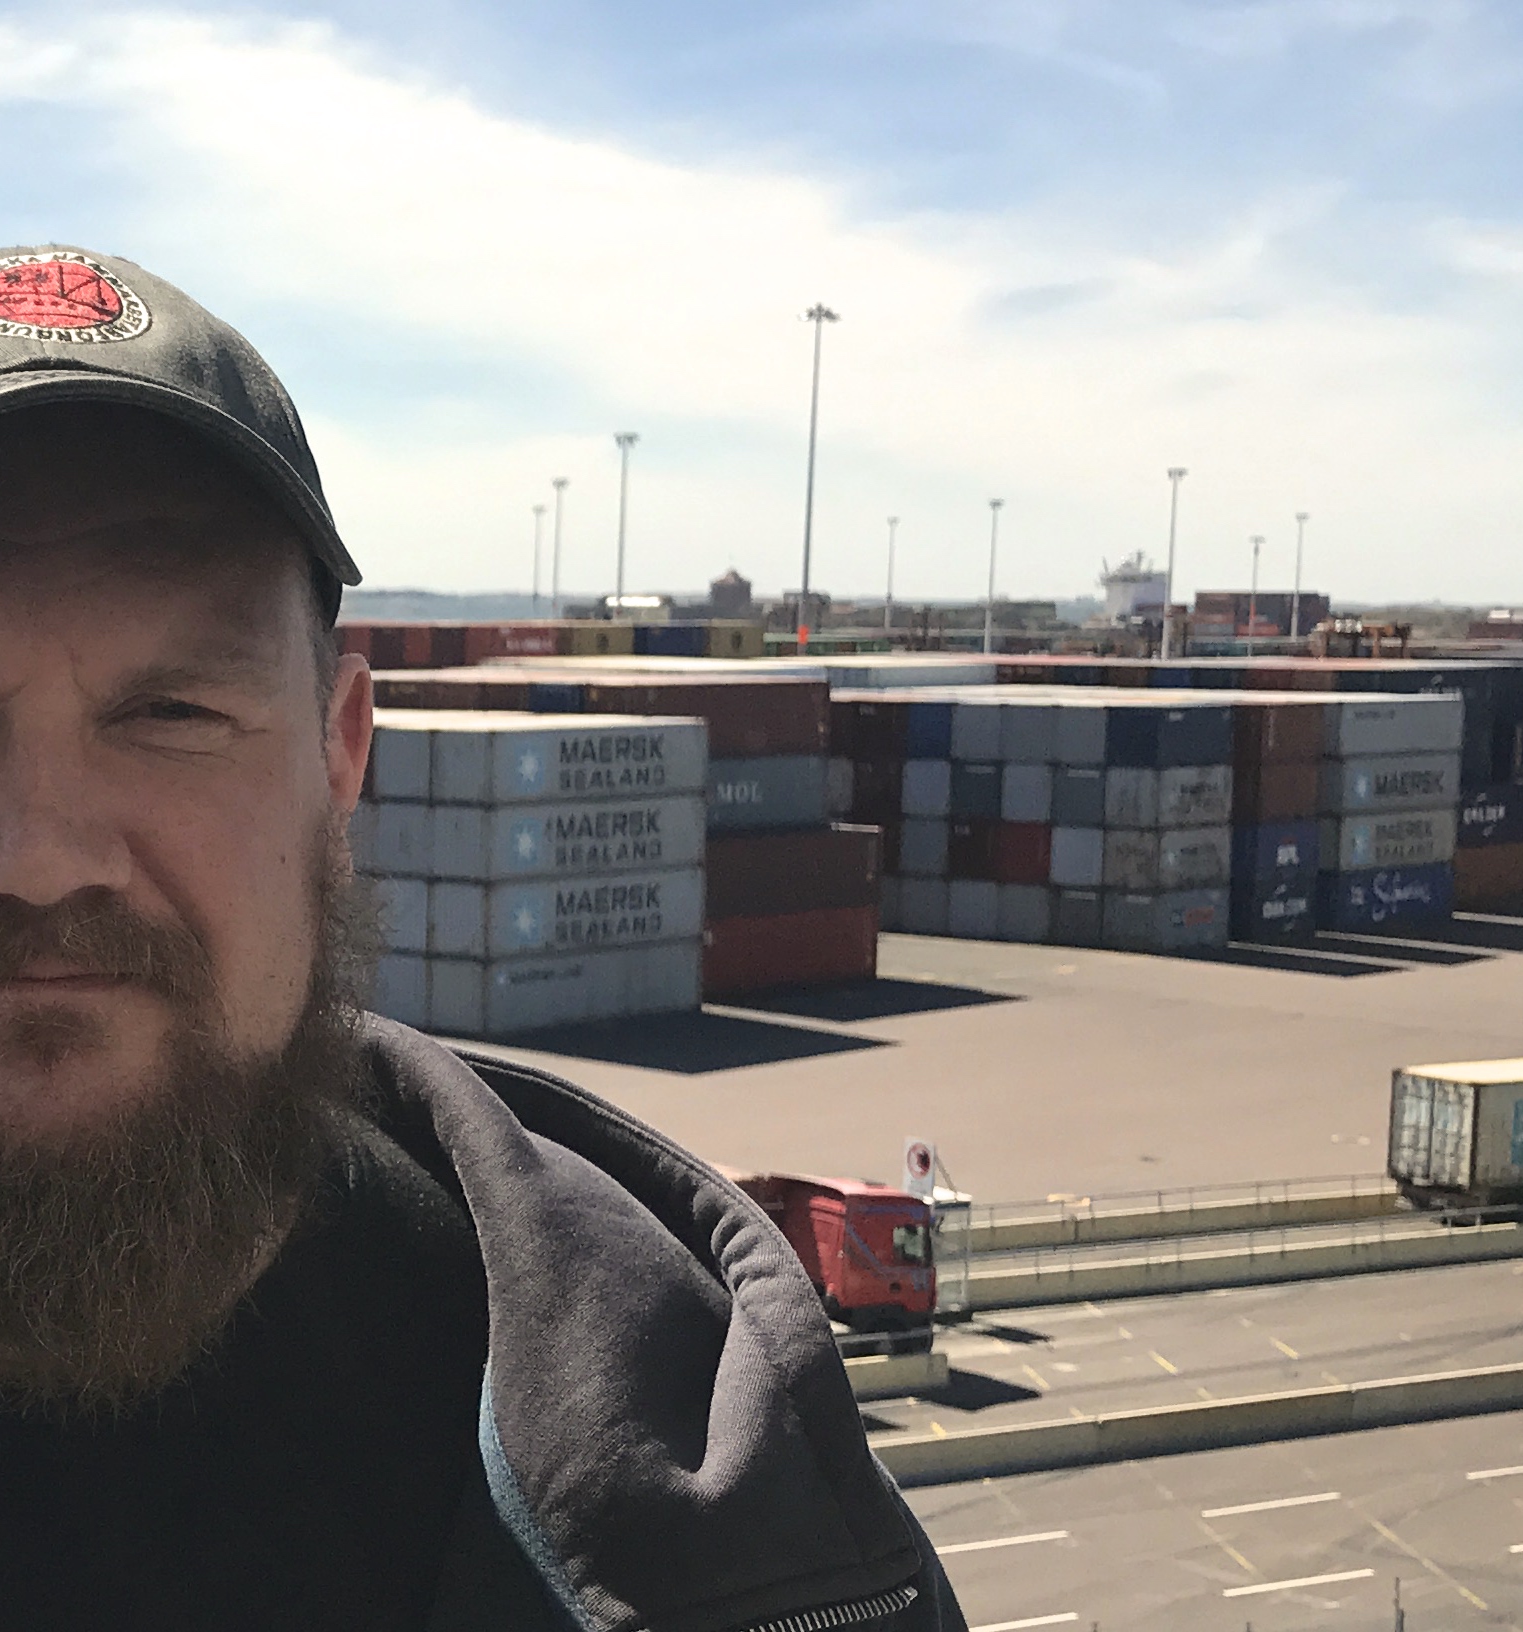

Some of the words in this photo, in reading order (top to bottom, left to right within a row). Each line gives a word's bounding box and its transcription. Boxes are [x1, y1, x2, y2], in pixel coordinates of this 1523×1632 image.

[559, 733, 665, 763] MAERSK
[559, 764, 666, 791] SEALAND
[557, 808, 661, 838] MAERSK
[556, 882, 661, 917] MAERSK
